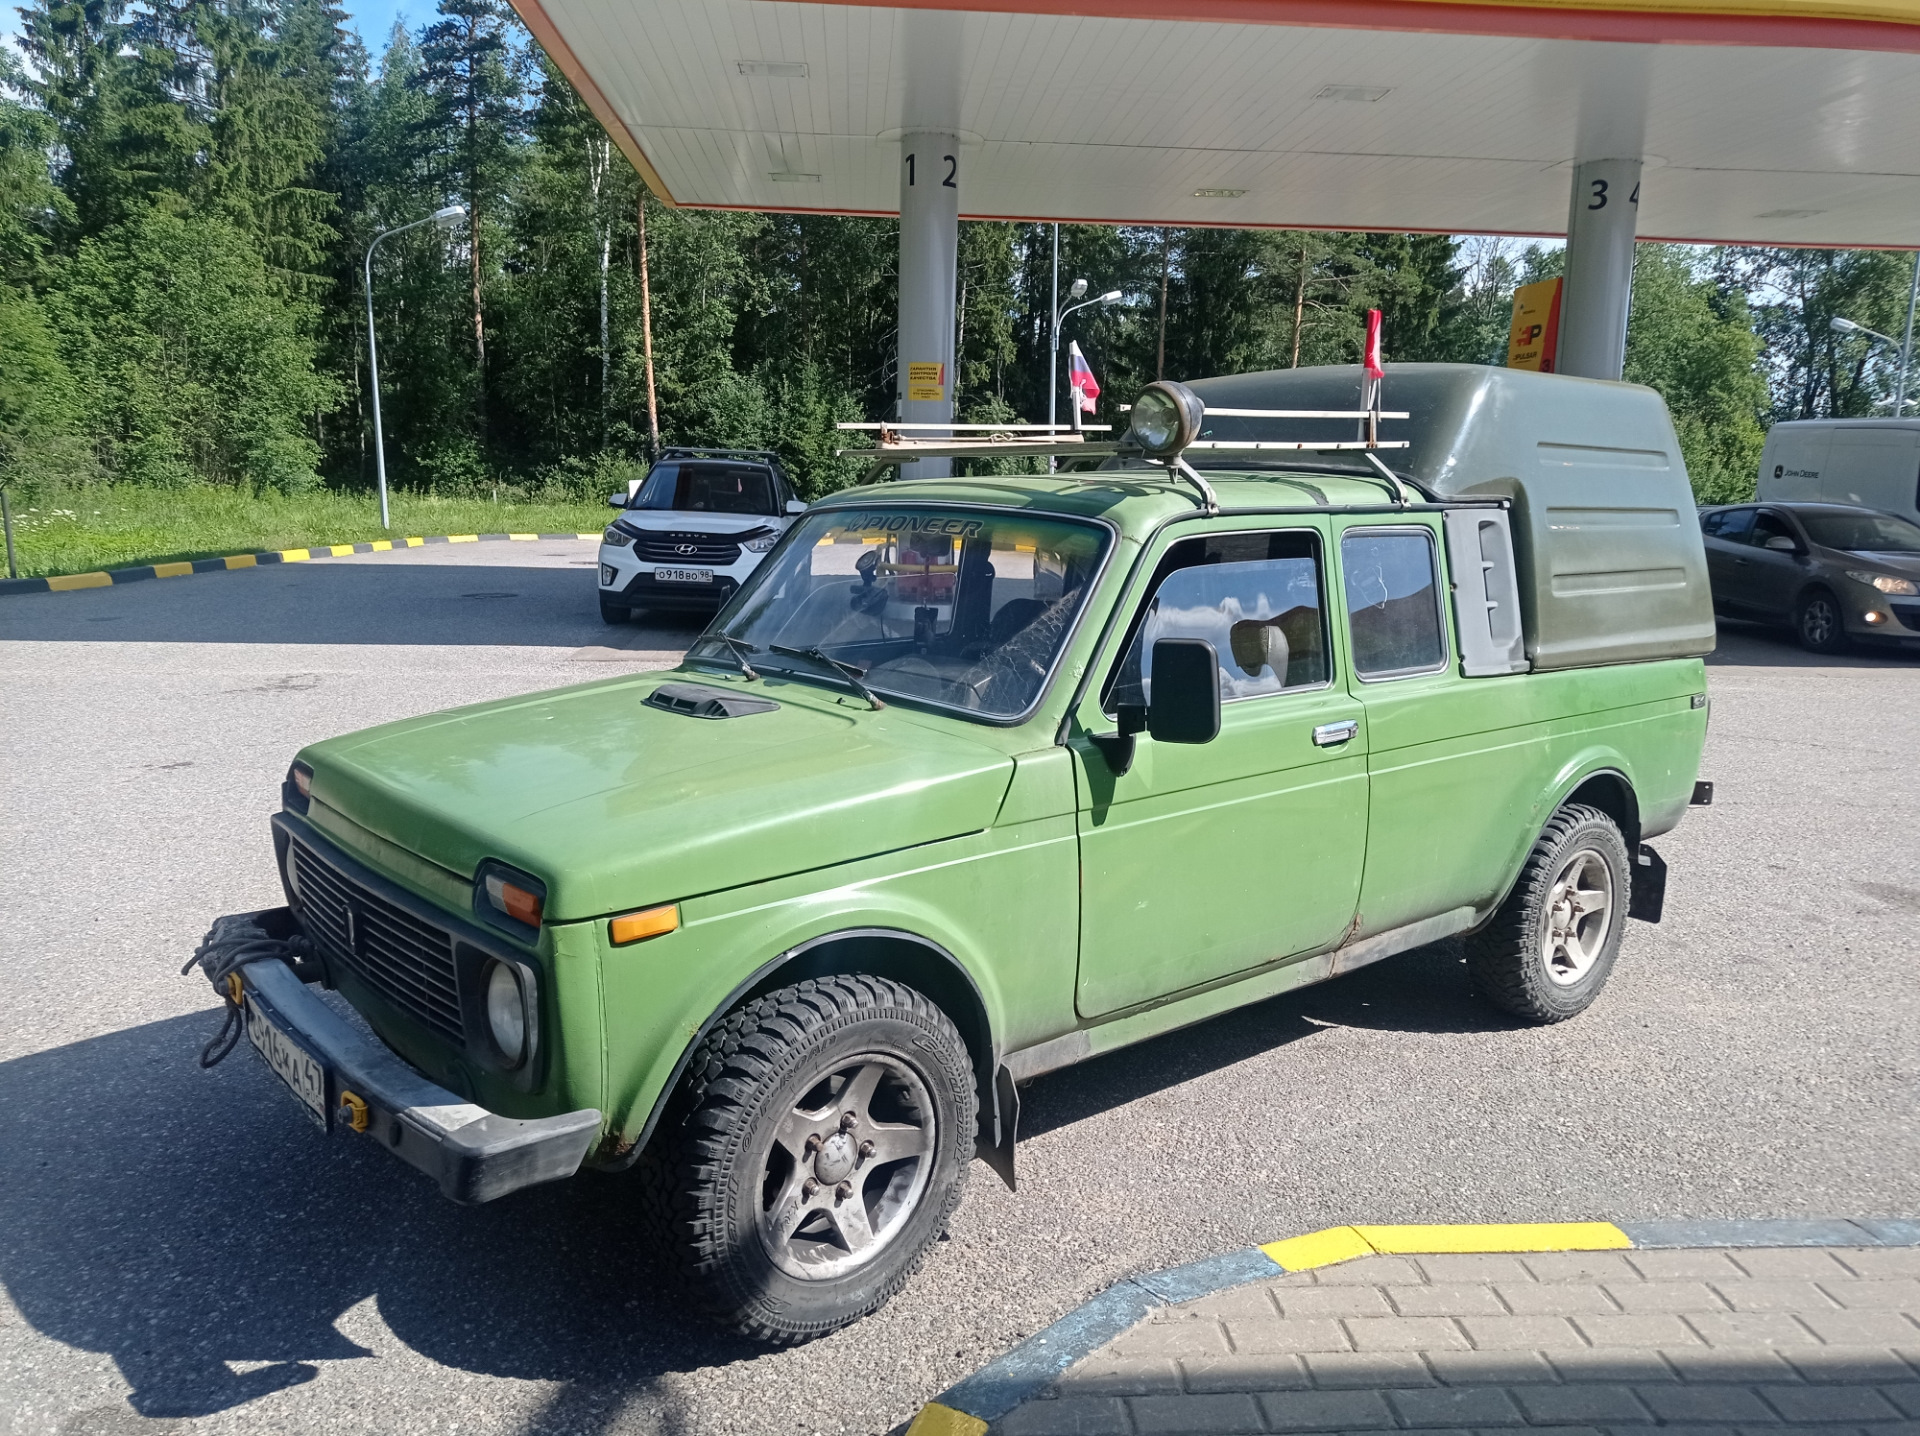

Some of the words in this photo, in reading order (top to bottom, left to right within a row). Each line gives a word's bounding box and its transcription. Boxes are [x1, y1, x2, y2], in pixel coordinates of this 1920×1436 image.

[905, 153, 915, 186] 1
[942, 155, 957, 189] 2
[1588, 179, 1608, 210] 3
[1629, 181, 1640, 212] 4
[1800, 469, 1819, 478] DEERE
[862, 514, 985, 538] PIONEER
